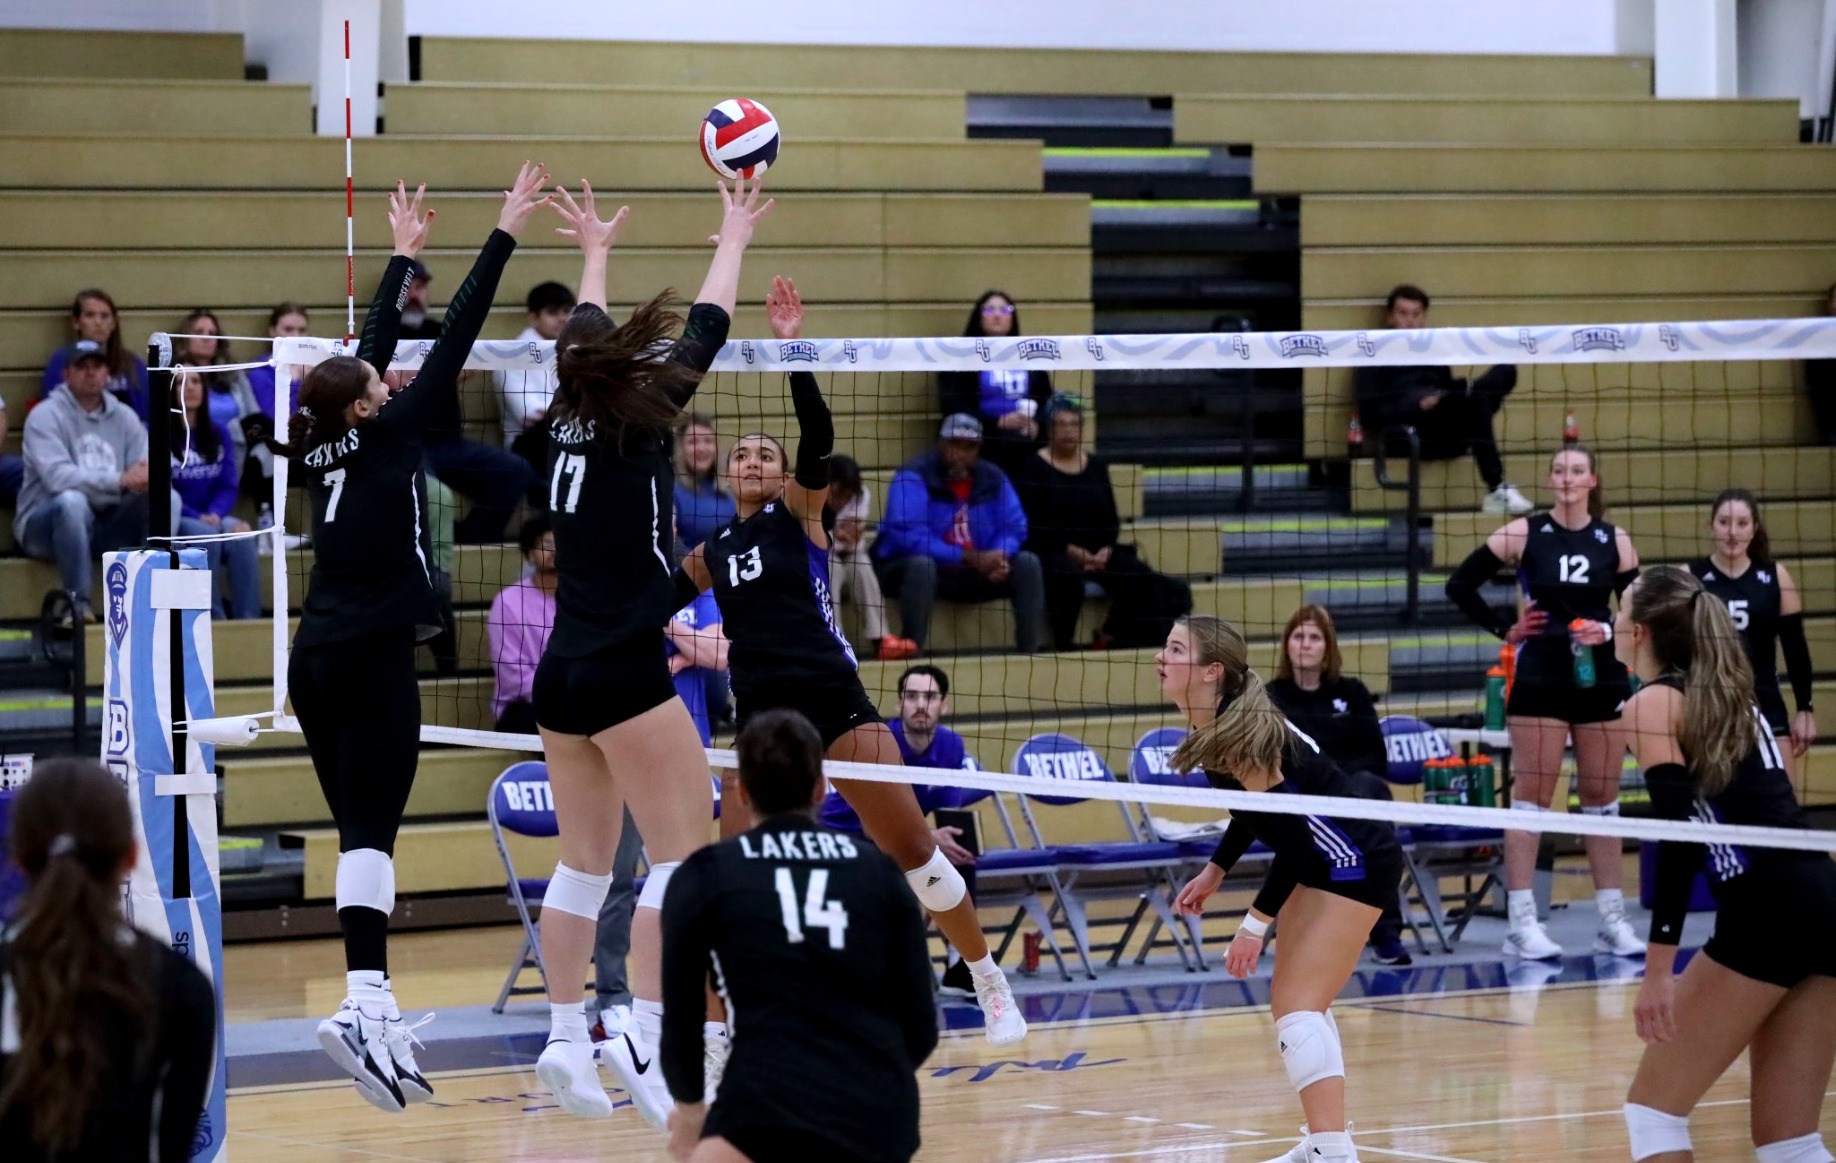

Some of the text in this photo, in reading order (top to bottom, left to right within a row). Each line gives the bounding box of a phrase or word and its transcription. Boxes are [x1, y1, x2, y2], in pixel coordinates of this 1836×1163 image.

[975, 338, 990, 362] BU
[1017, 338, 1061, 360] BETHEL
[1087, 337, 1104, 360] BU
[1233, 335, 1250, 360] BU
[1279, 334, 1329, 357] BETHEL
[1357, 333, 1376, 357] BU
[1519, 329, 1537, 354] BU
[1572, 327, 1626, 351] BETHEL
[1658, 325, 1680, 351] BU
[528, 341, 542, 364] BU
[742, 341, 754, 364] BU
[780, 341, 819, 362] BETHEL
[844, 340, 857, 363] BU
[304, 428, 359, 467] LAKRS
[550, 451, 586, 513] 17
[322, 468, 346, 523] 7
[728, 546, 763, 588] 13
[1559, 554, 1590, 584] 12
[1024, 750, 1104, 780] BETHEL
[501, 780, 555, 811] BET
[739, 831, 859, 859] LAKERS
[775, 867, 848, 950] 14
